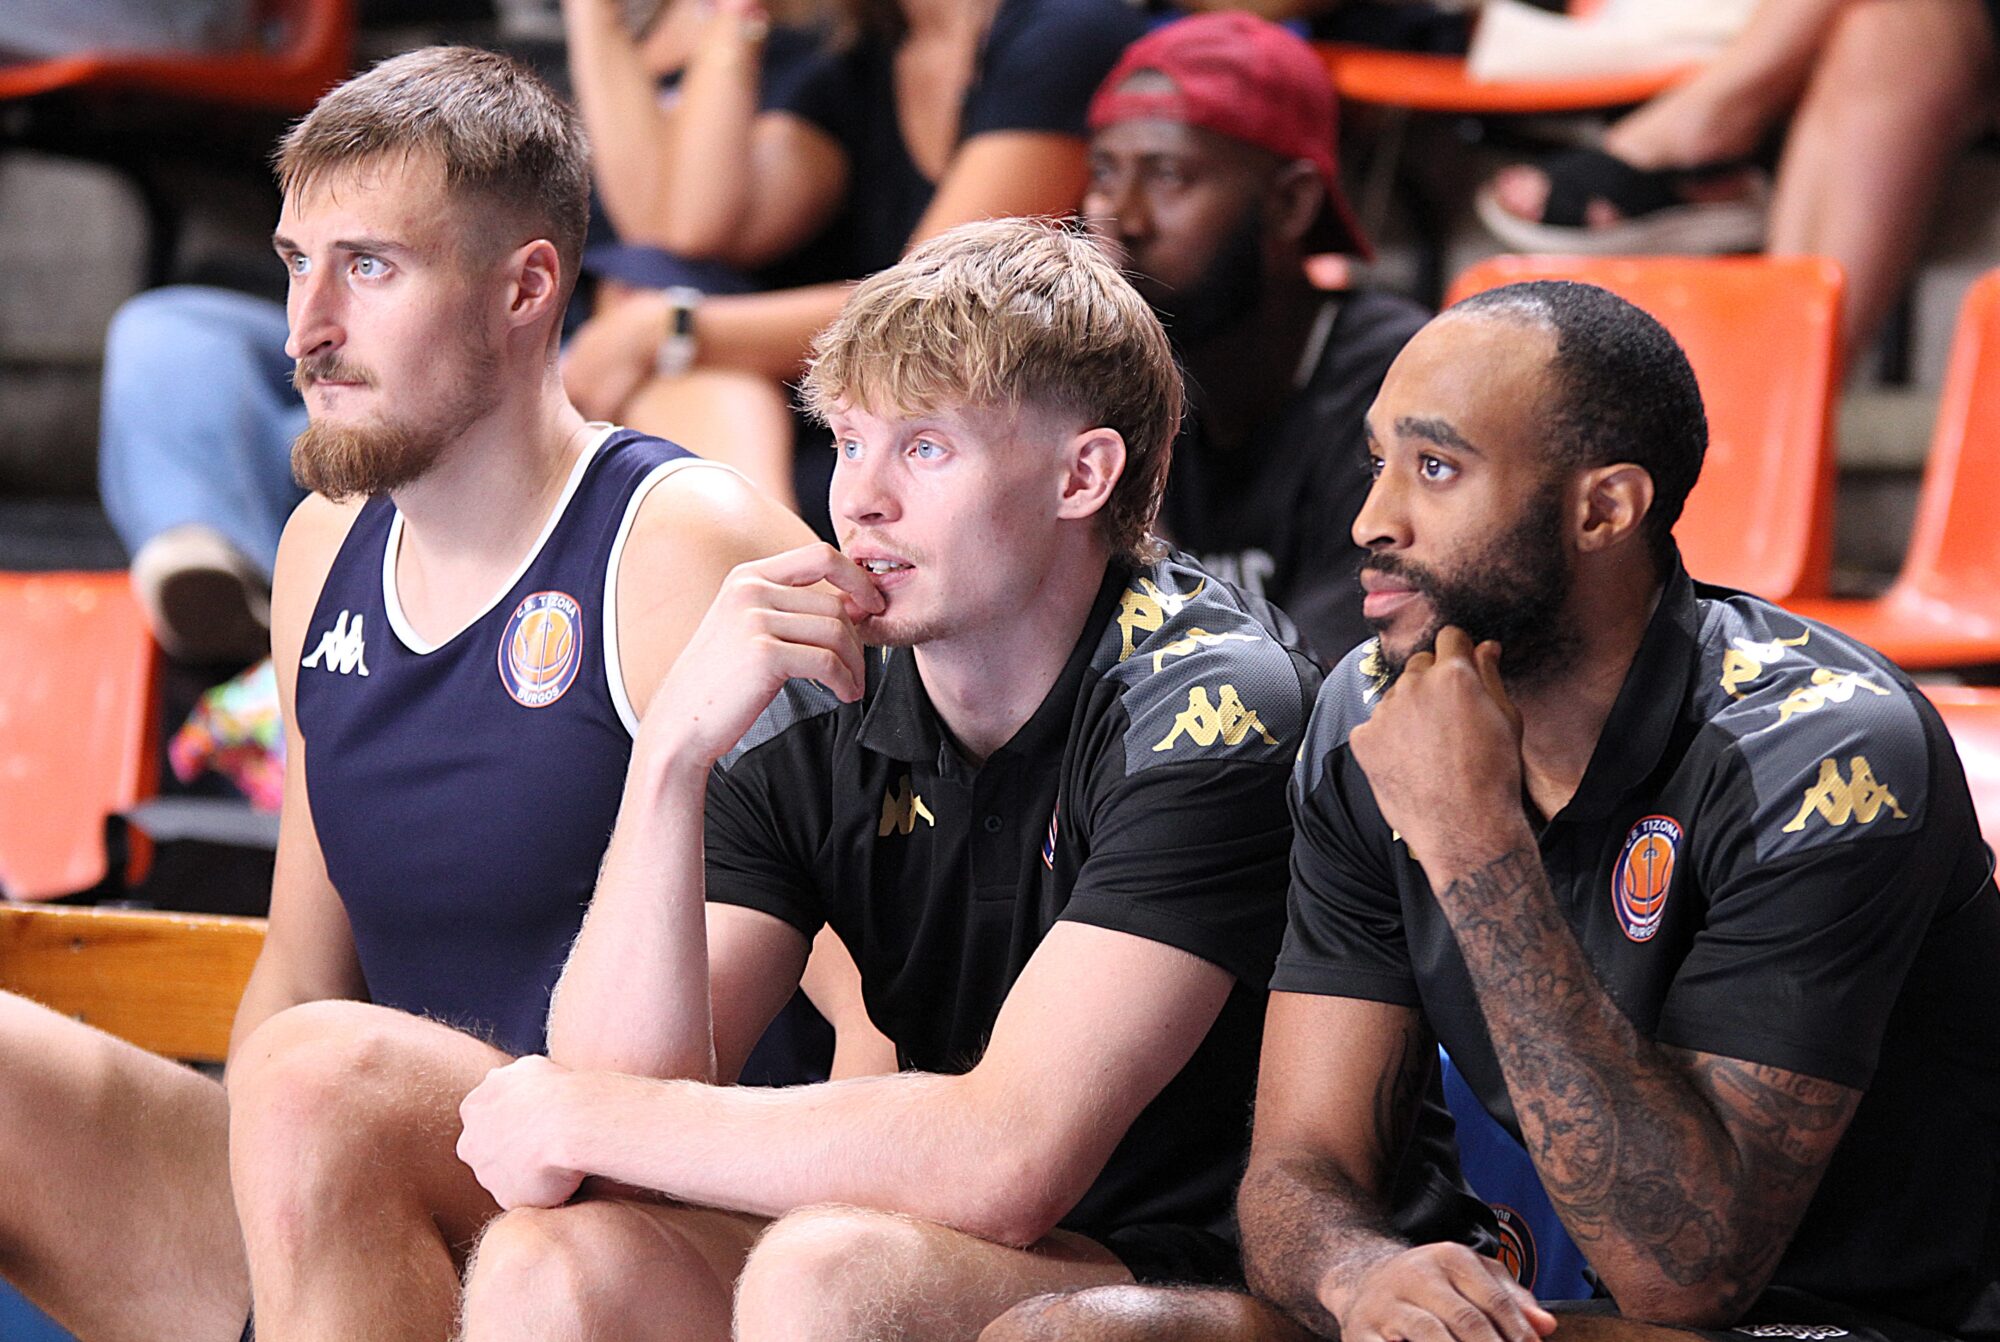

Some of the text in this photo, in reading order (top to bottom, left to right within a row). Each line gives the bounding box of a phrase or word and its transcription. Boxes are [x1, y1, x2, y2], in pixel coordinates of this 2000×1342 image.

[538, 595, 577, 618] TIZONA
[516, 685, 560, 704] BURGOS
[1641, 819, 1679, 841] TIZONA
